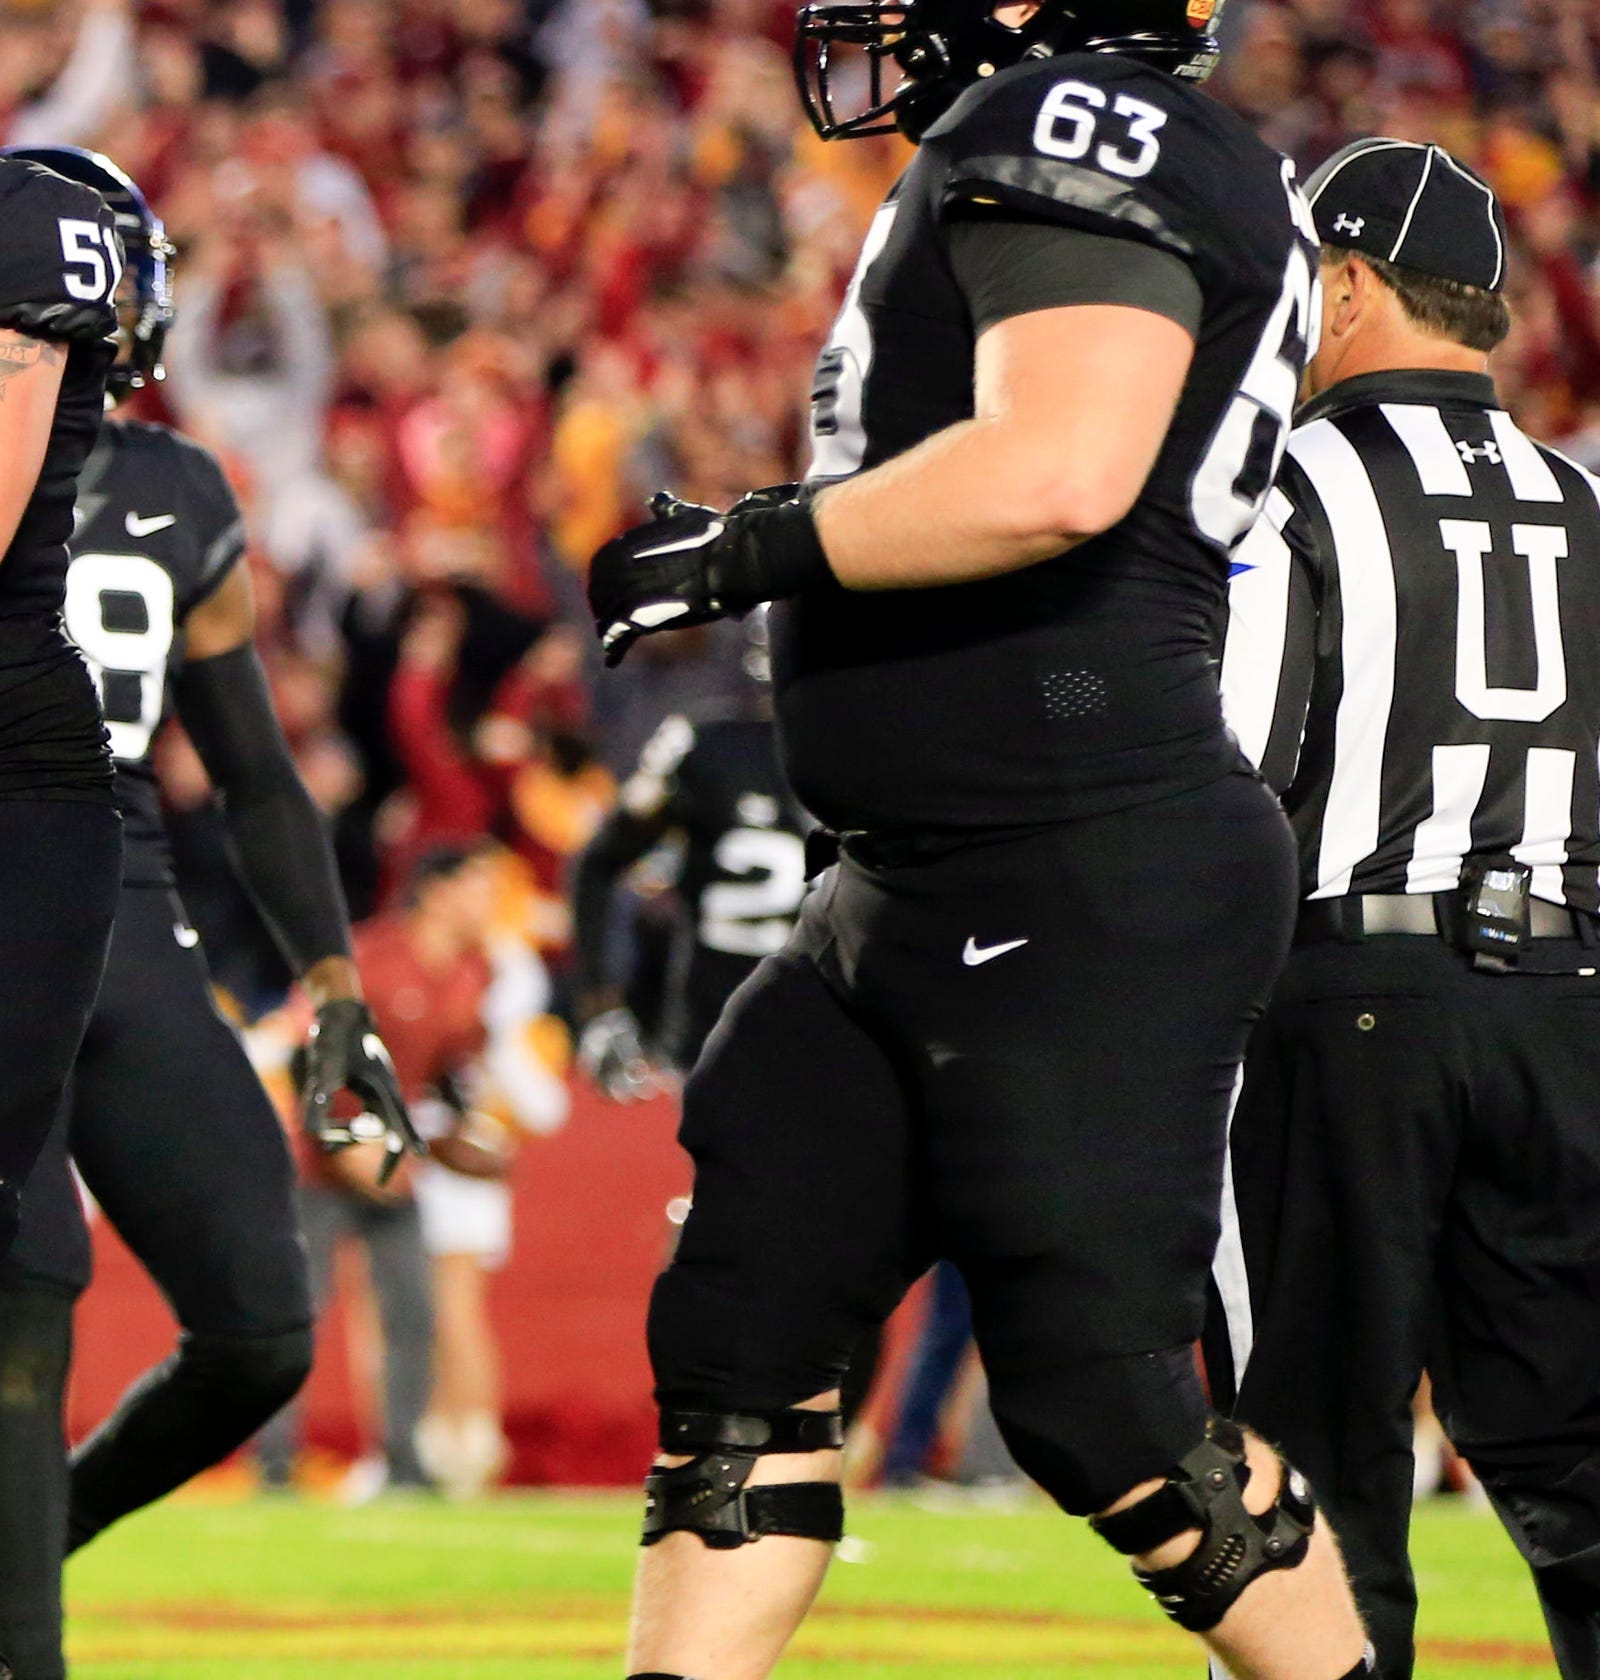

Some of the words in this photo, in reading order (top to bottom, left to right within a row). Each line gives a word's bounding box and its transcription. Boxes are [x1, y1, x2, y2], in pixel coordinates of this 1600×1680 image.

[1032, 80, 1169, 178] 63
[57, 217, 123, 308] 51
[1437, 517, 1570, 723] U
